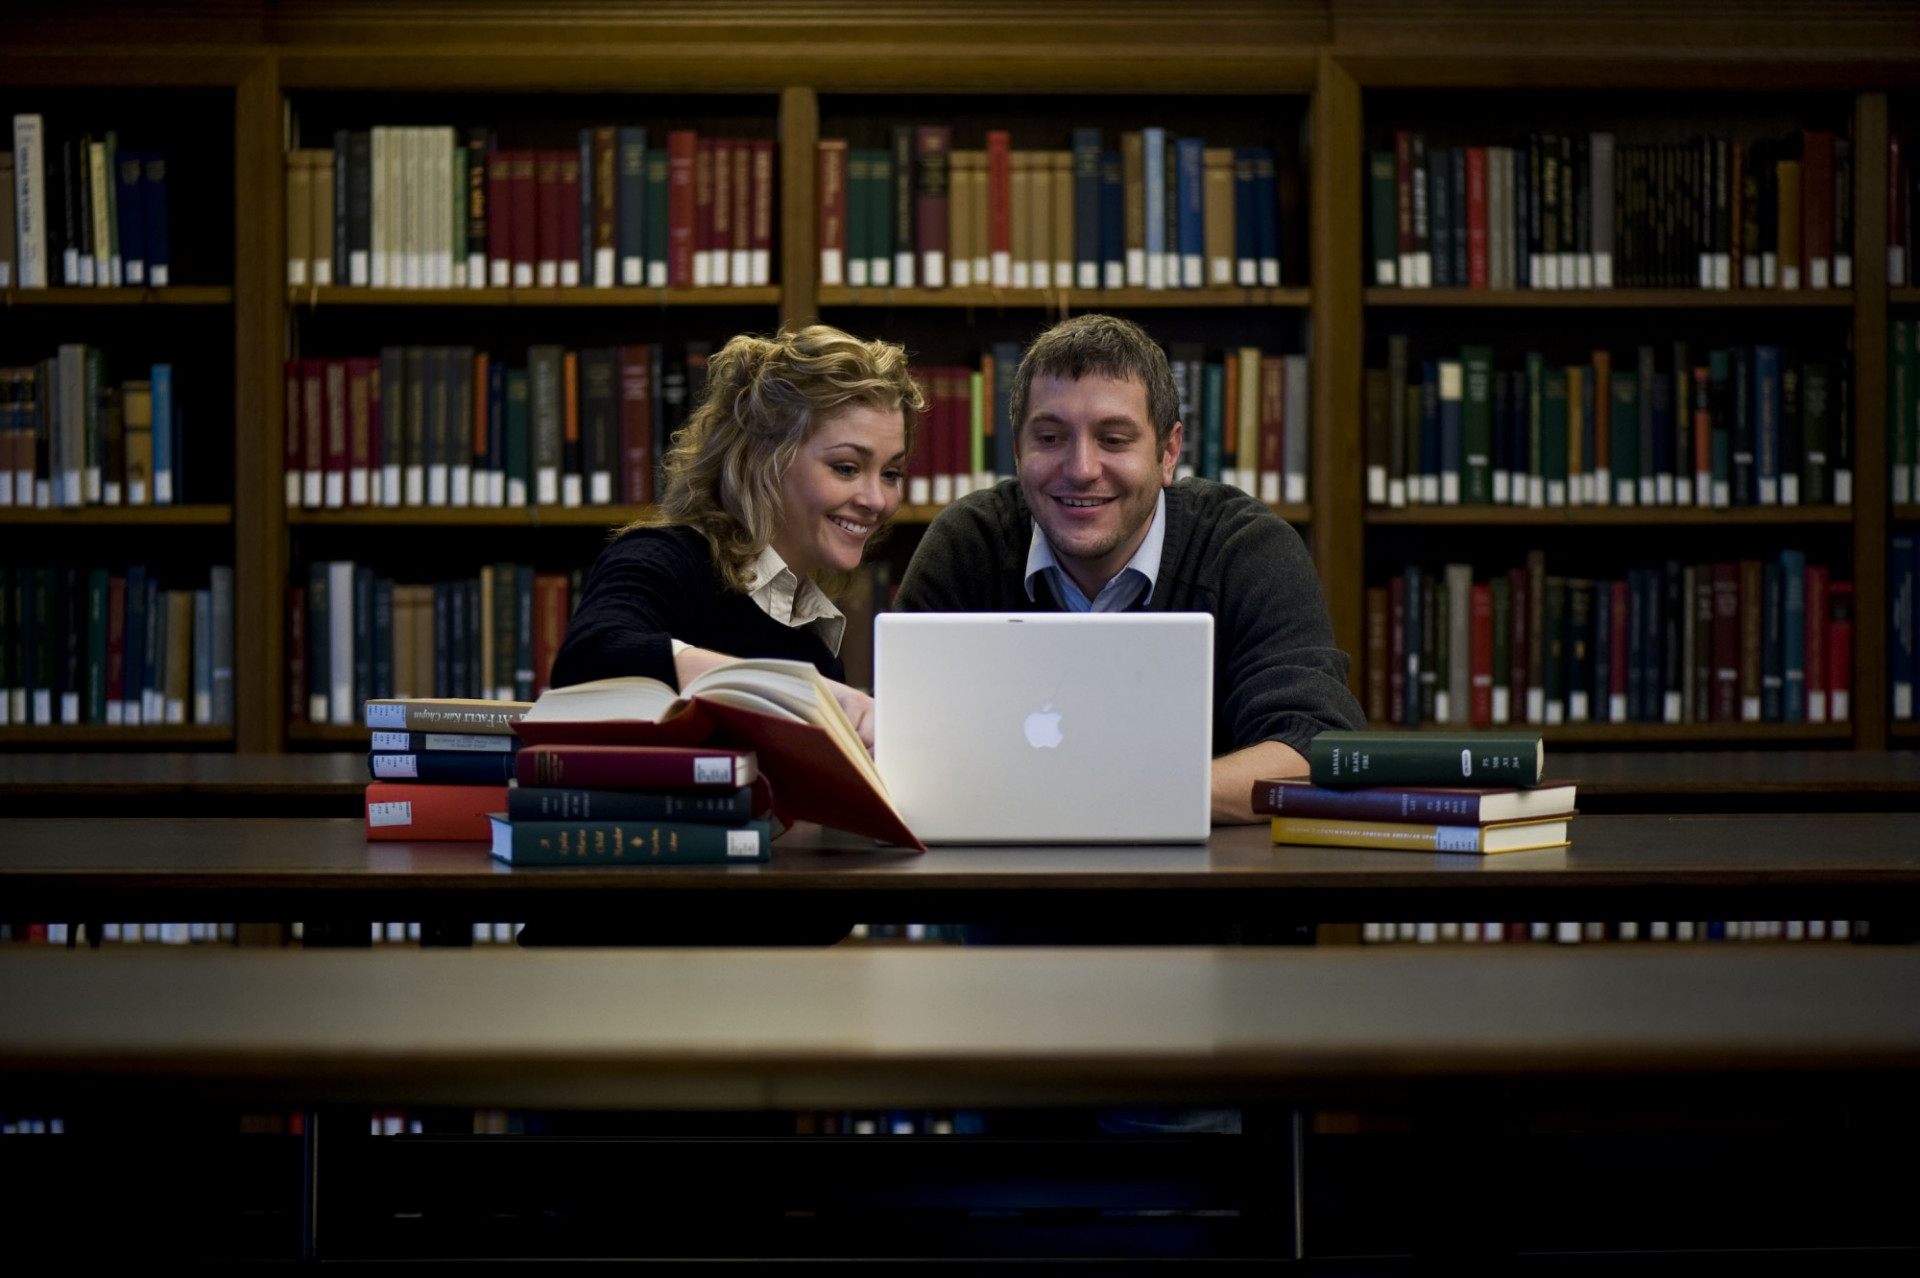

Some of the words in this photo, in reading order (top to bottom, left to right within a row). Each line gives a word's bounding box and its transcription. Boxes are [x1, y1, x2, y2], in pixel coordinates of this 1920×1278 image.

[413, 709, 441, 721] Chopin
[443, 711, 462, 723] Kate
[463, 713, 495, 728] FAULT
